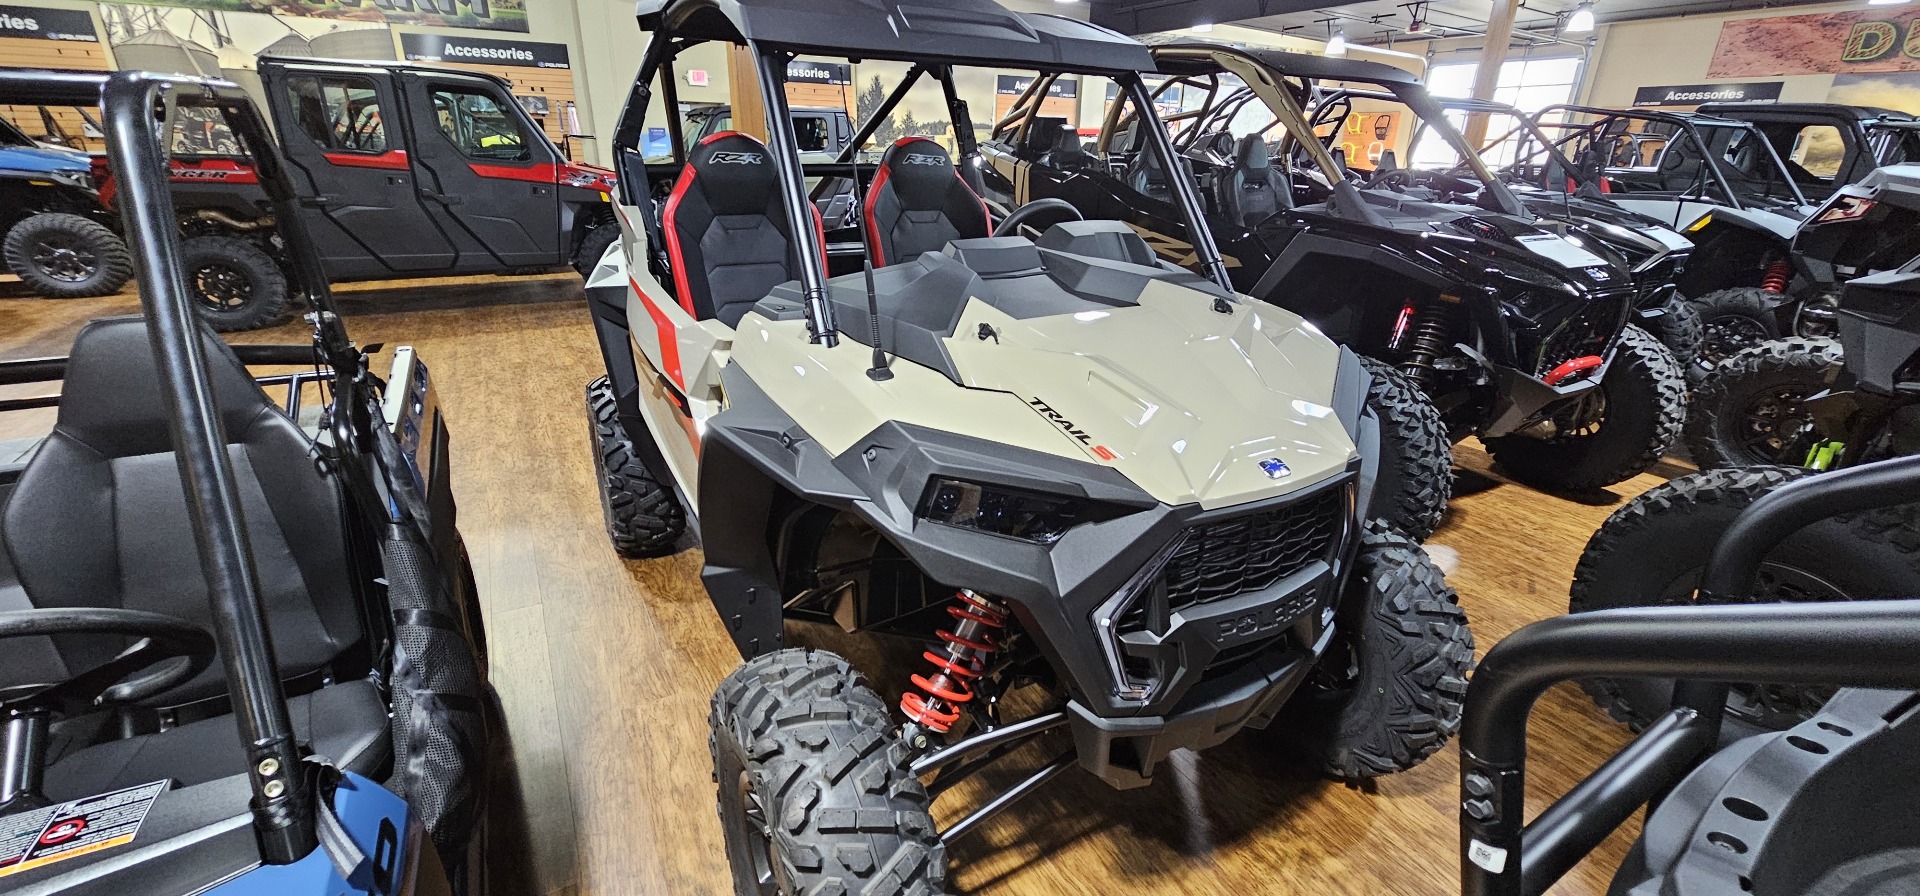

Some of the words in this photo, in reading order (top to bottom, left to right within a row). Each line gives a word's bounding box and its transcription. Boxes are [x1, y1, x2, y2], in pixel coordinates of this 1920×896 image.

[444, 43, 534, 61] Accessories
[1665, 89, 1744, 101] Accessories
[709, 151, 763, 165] RZR
[903, 153, 946, 166] RZR
[1029, 396, 1091, 446] TRAIL
[1090, 445, 1118, 461] S
[1215, 588, 1318, 643] POLARIS
